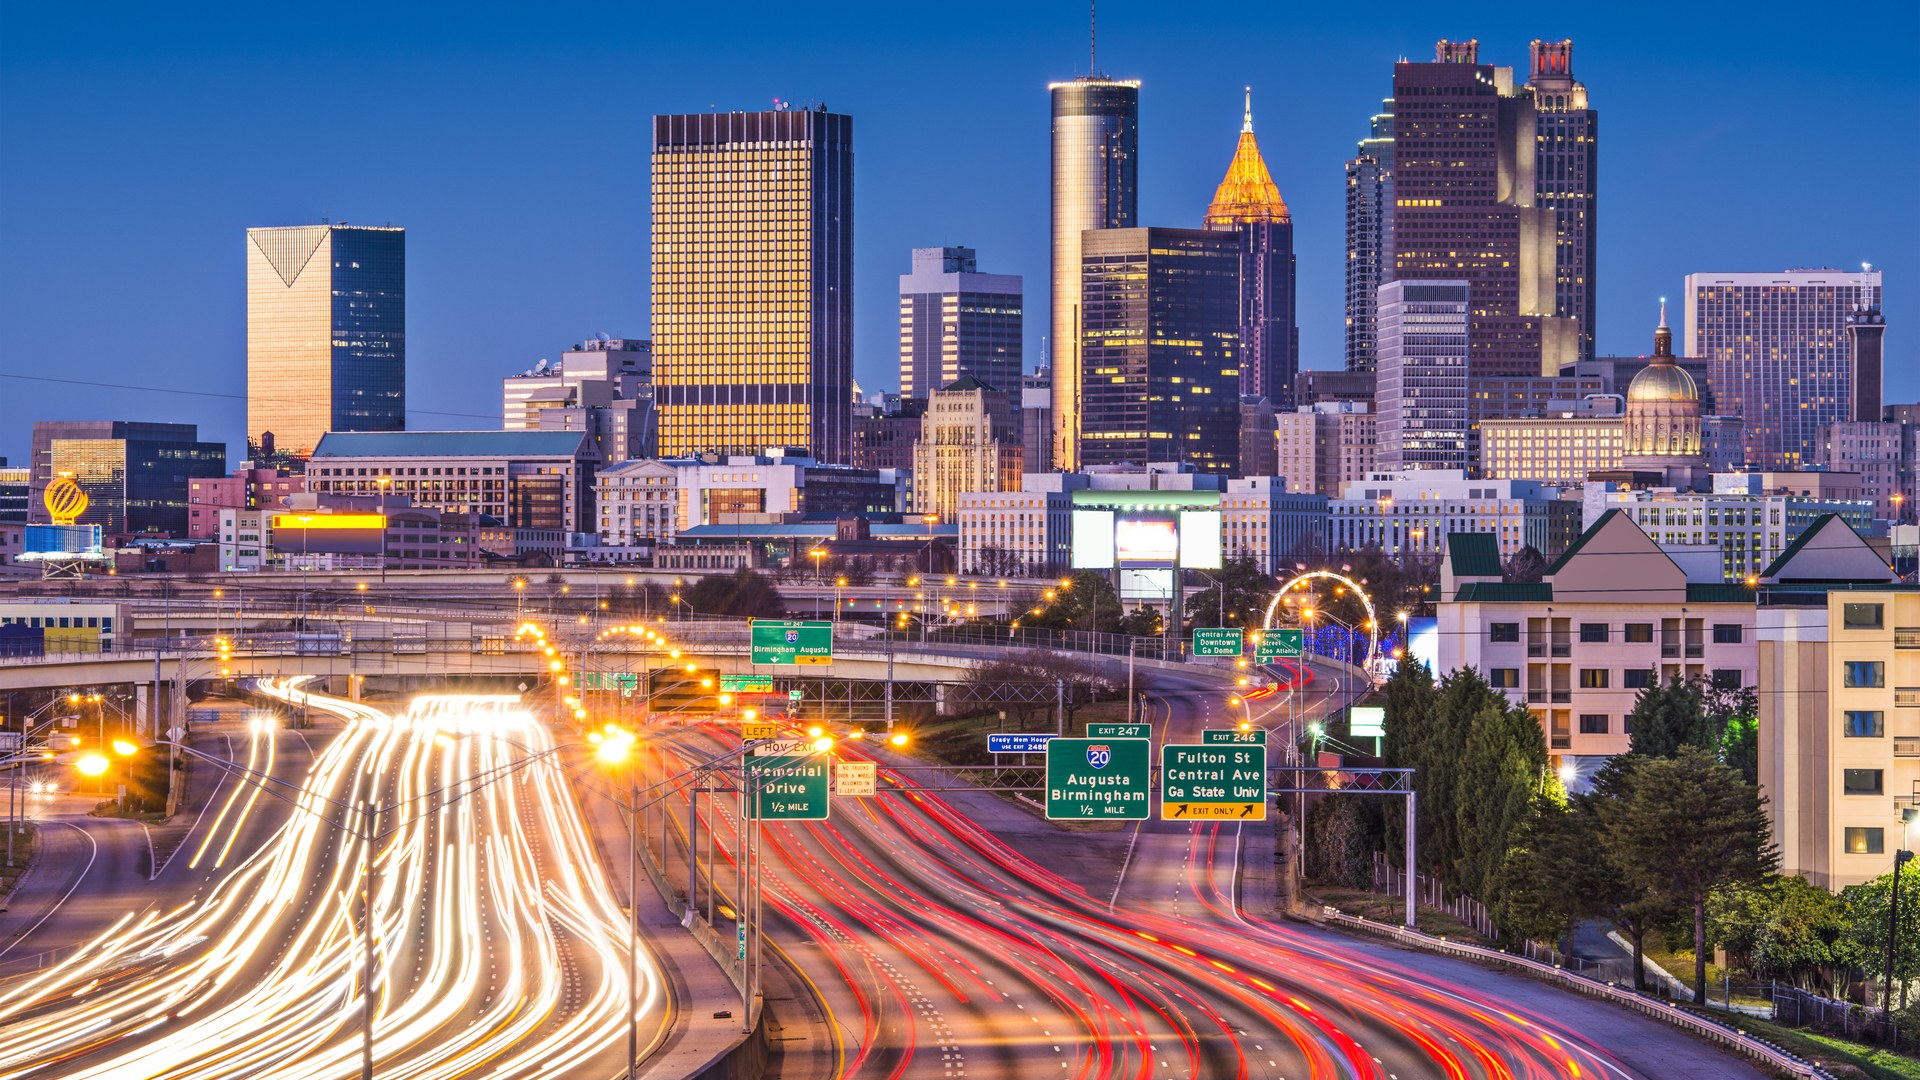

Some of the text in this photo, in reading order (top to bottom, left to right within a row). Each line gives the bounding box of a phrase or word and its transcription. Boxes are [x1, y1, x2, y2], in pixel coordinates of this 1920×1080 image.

[754, 646, 795, 654] Birmingham
[1118, 727, 1140, 736] 247
[1233, 733, 1256, 742] 246
[765, 743, 788, 752] HOV
[1091, 751, 1109, 764] 20
[1178, 752, 1250, 763] Fulton St
[751, 766, 821, 777] Memorial
[1168, 769, 1260, 780] Central Ave
[1067, 774, 1130, 789] Augusta
[766, 783, 806, 794] Drive
[1168, 786, 1260, 797] Ga State Univ
[1052, 790, 1145, 804] Birmingham
[788, 803, 809, 811] MILE
